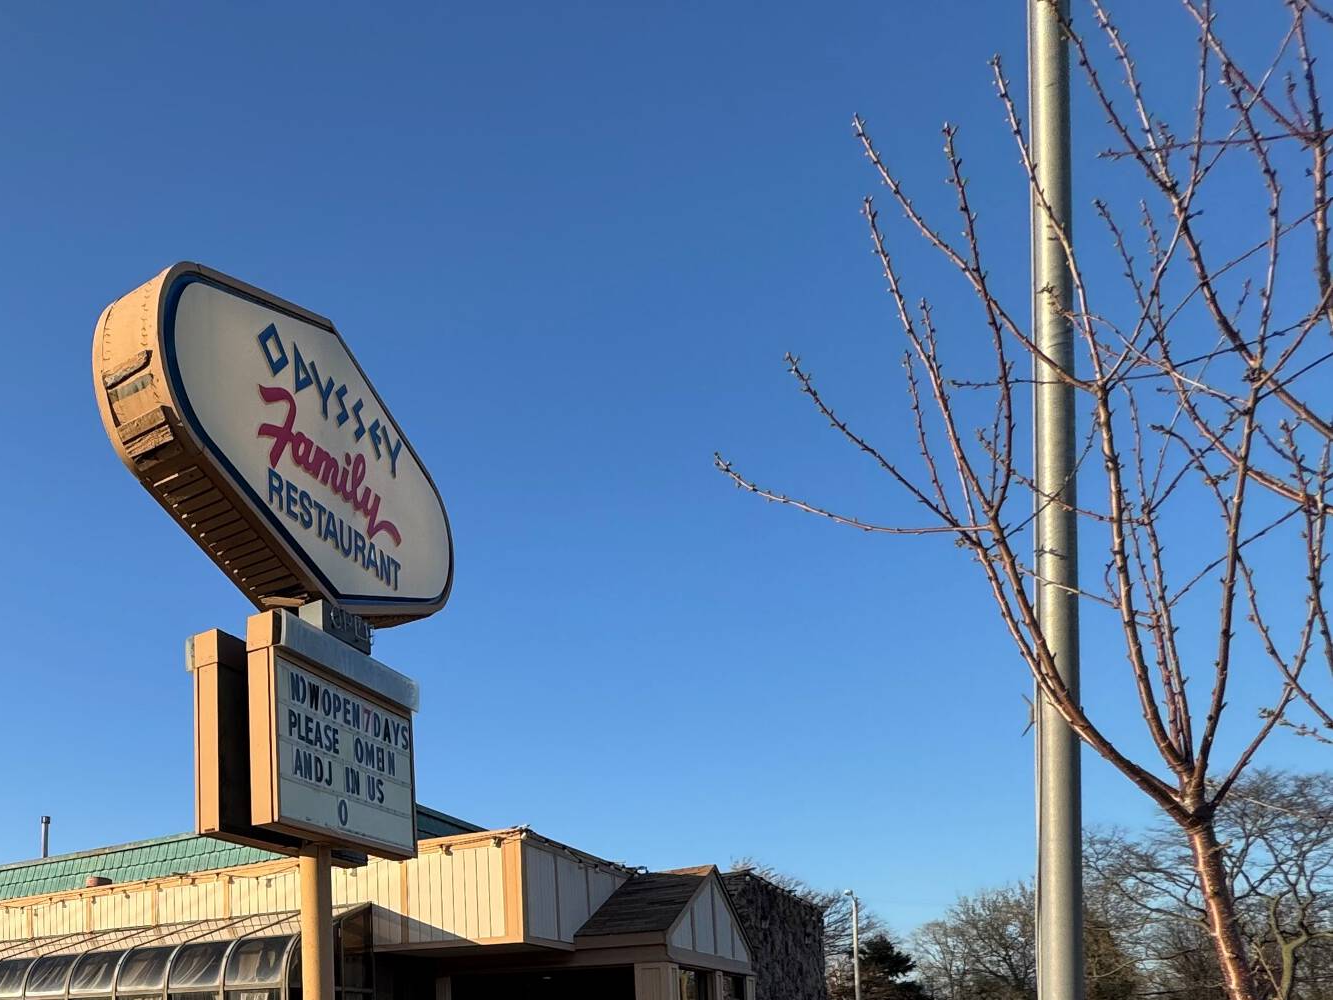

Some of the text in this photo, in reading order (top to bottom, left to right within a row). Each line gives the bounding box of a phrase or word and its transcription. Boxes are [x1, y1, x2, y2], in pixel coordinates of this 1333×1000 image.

[258, 383, 402, 548] Family
[267, 467, 402, 591] RESTAURANT
[288, 709, 340, 754] PLEASE
[367, 774, 385, 804] US
